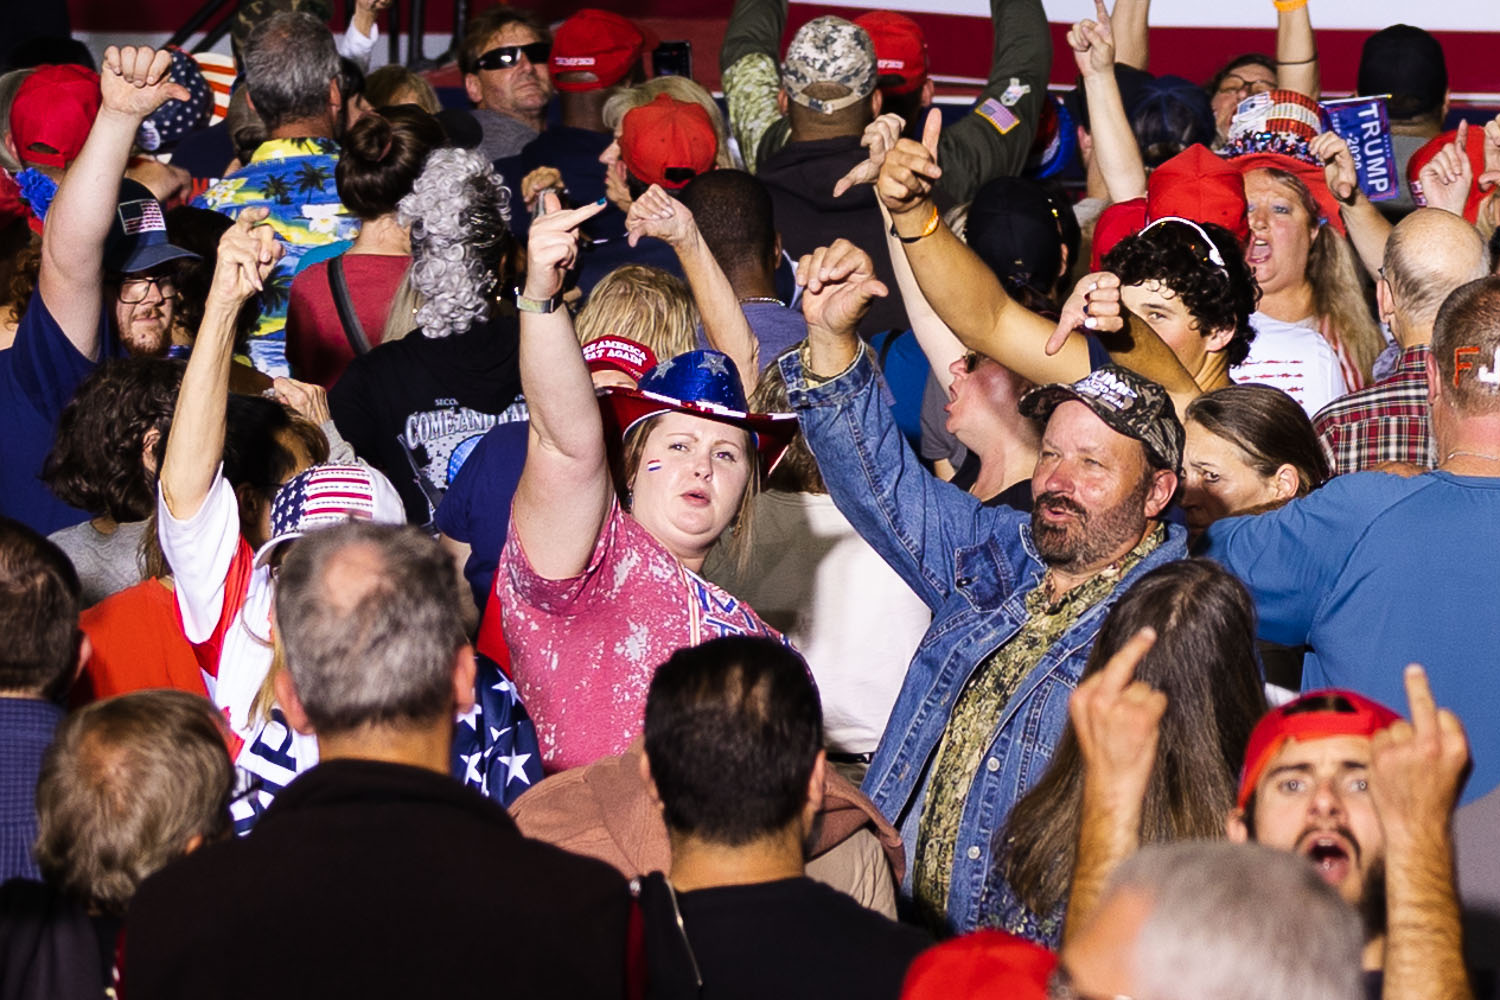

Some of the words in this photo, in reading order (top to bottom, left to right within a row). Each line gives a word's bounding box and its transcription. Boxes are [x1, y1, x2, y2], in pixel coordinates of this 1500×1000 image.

[1358, 103, 1390, 193] TRUMP
[597, 340, 648, 361] AMERICA
[607, 349, 643, 367] AGAIN
[405, 407, 456, 450] COME
[456, 406, 496, 432] AND
